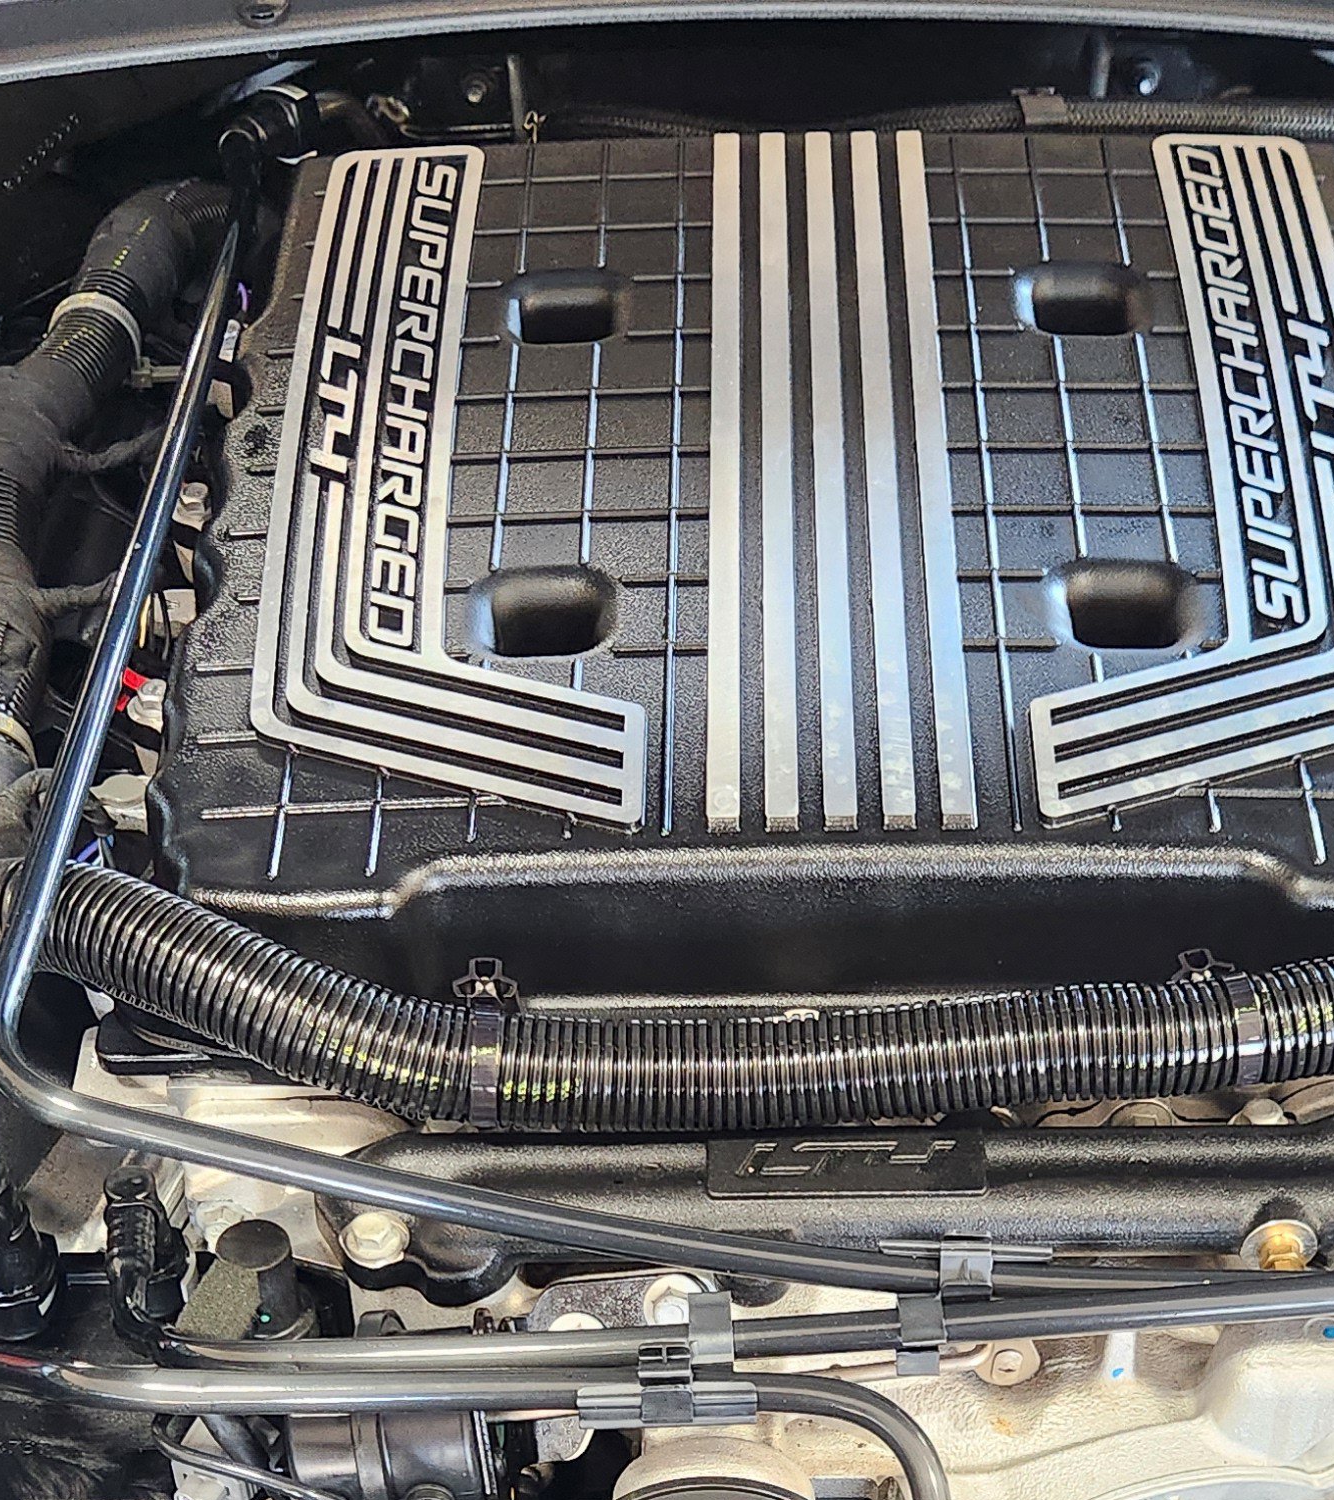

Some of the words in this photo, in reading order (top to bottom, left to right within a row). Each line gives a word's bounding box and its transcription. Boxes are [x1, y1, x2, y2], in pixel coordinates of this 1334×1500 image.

[309, 335, 362, 475] LT4
[368, 160, 459, 649] SUPERCHARGED
[1178, 144, 1306, 625] SUPERCHARGED
